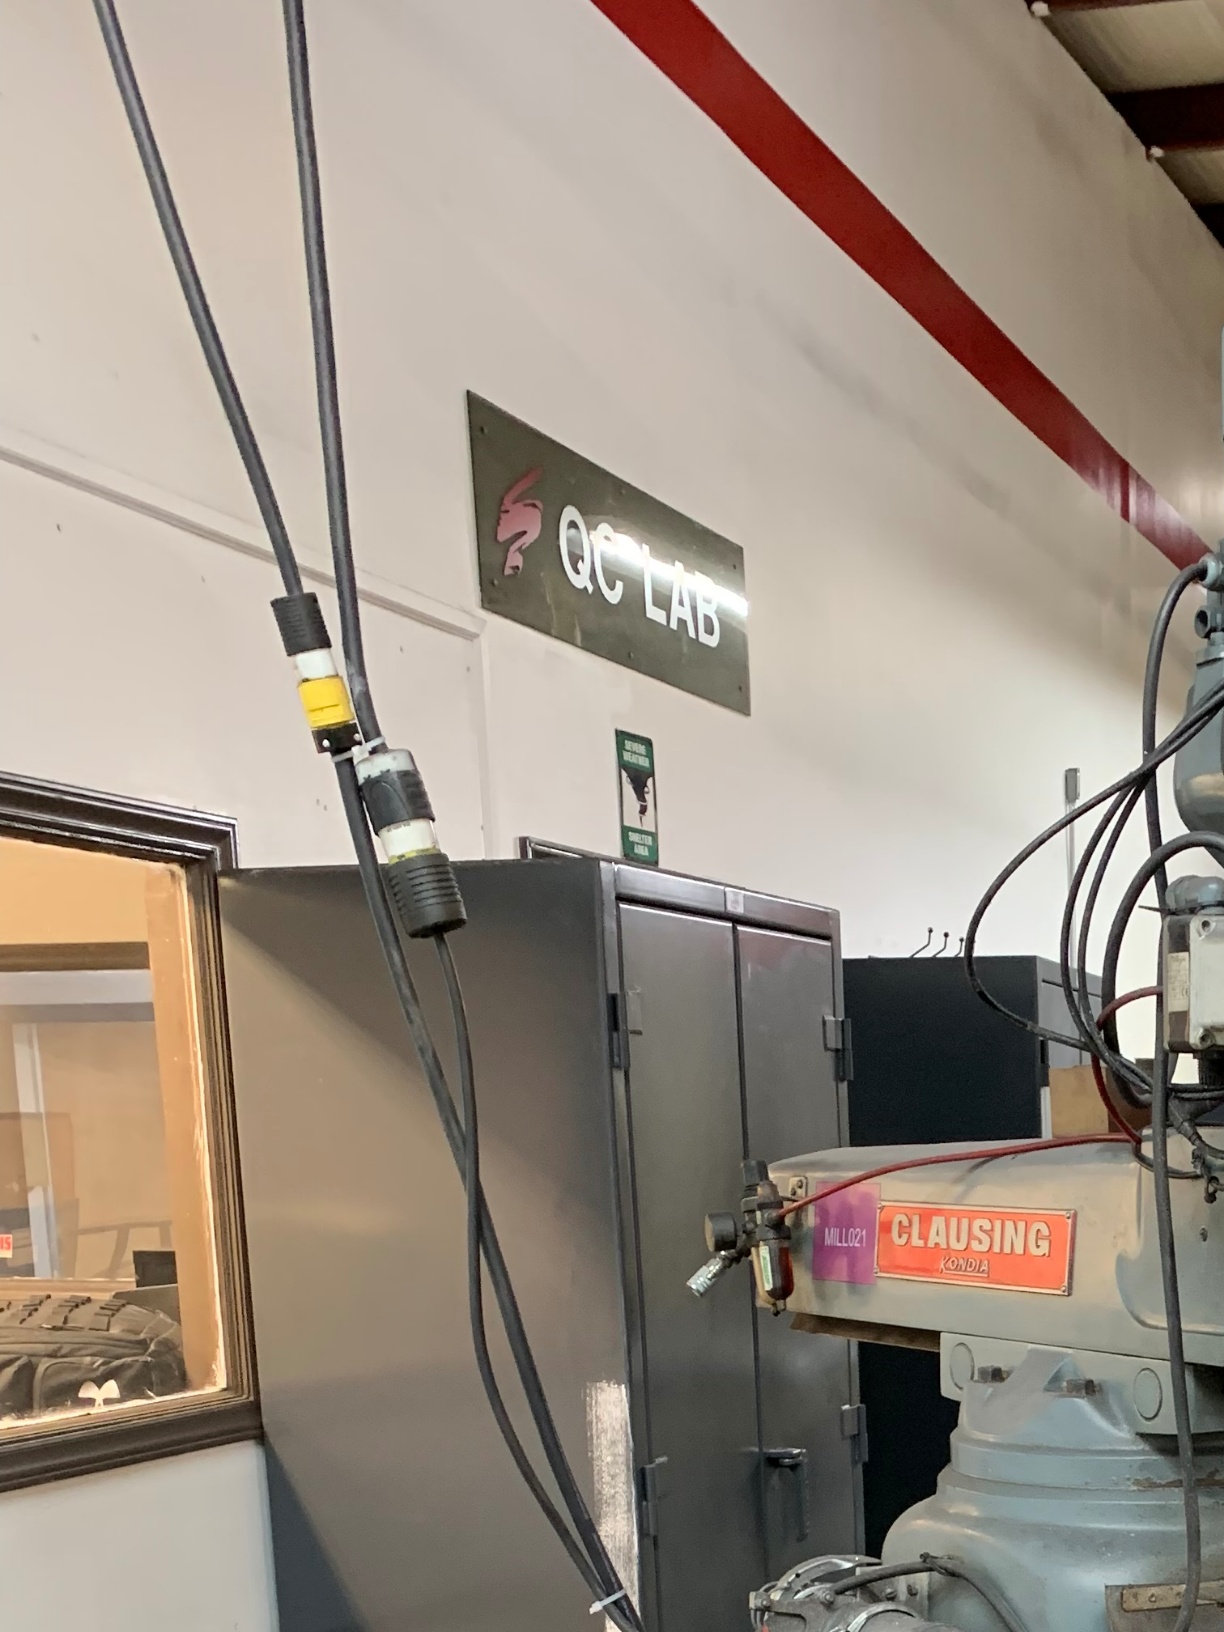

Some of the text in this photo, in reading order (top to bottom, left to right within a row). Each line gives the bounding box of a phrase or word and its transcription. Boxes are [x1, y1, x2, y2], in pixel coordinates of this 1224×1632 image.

[558, 504, 721, 649] QC LAB
[824, 1227, 867, 1247] MILL021
[891, 1213, 1051, 1257] CLAUSING
[940, 1256, 989, 1277] KONDIA
